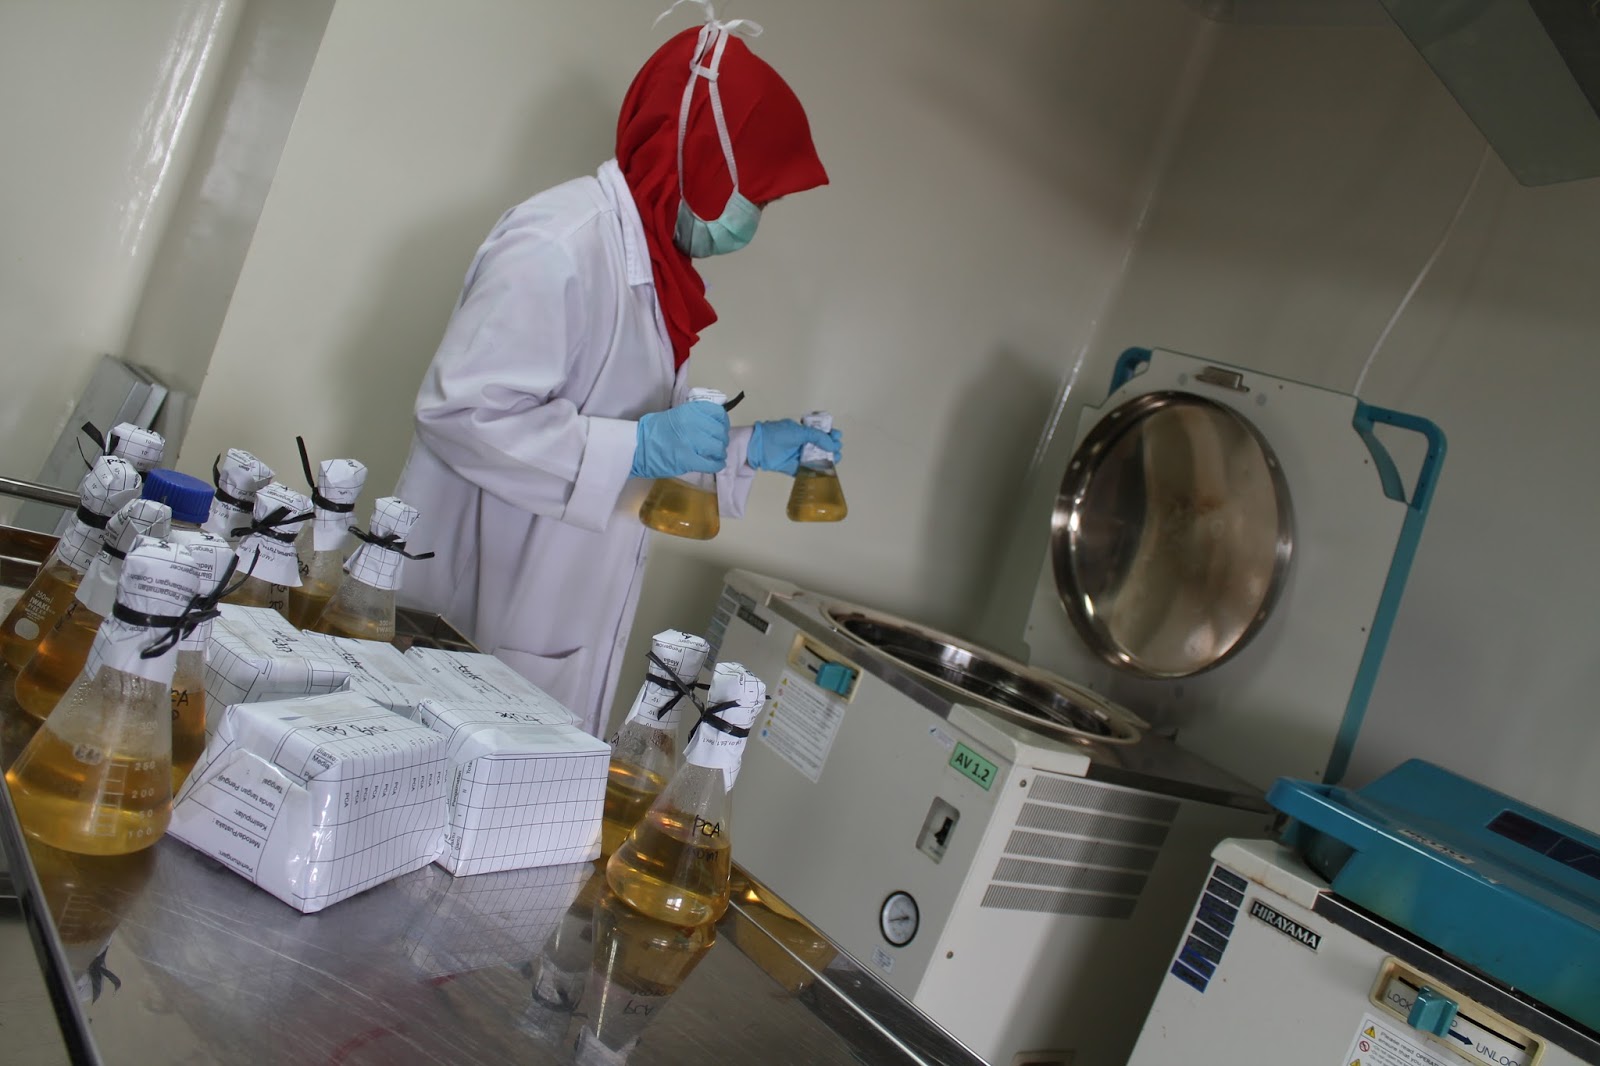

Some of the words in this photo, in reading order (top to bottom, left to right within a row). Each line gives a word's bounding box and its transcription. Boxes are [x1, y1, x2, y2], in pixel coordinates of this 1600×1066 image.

[30, 596, 50, 612] IWAKI
[312, 755, 331, 770] Media
[954, 752, 973, 770] AV
[972, 763, 990, 782] 1.2
[218, 774, 240, 791] Penguji
[262, 778, 283, 794] Tanggal
[132, 788, 154, 799] 200
[240, 785, 258, 802] tangan
[259, 796, 276, 811] Tanda
[233, 808, 268, 831] Kesimpulan:
[692, 814, 721, 838] PCA
[215, 819, 260, 848] Metode/Pustaka
[1252, 903, 1317, 948] HIRAYAMA
